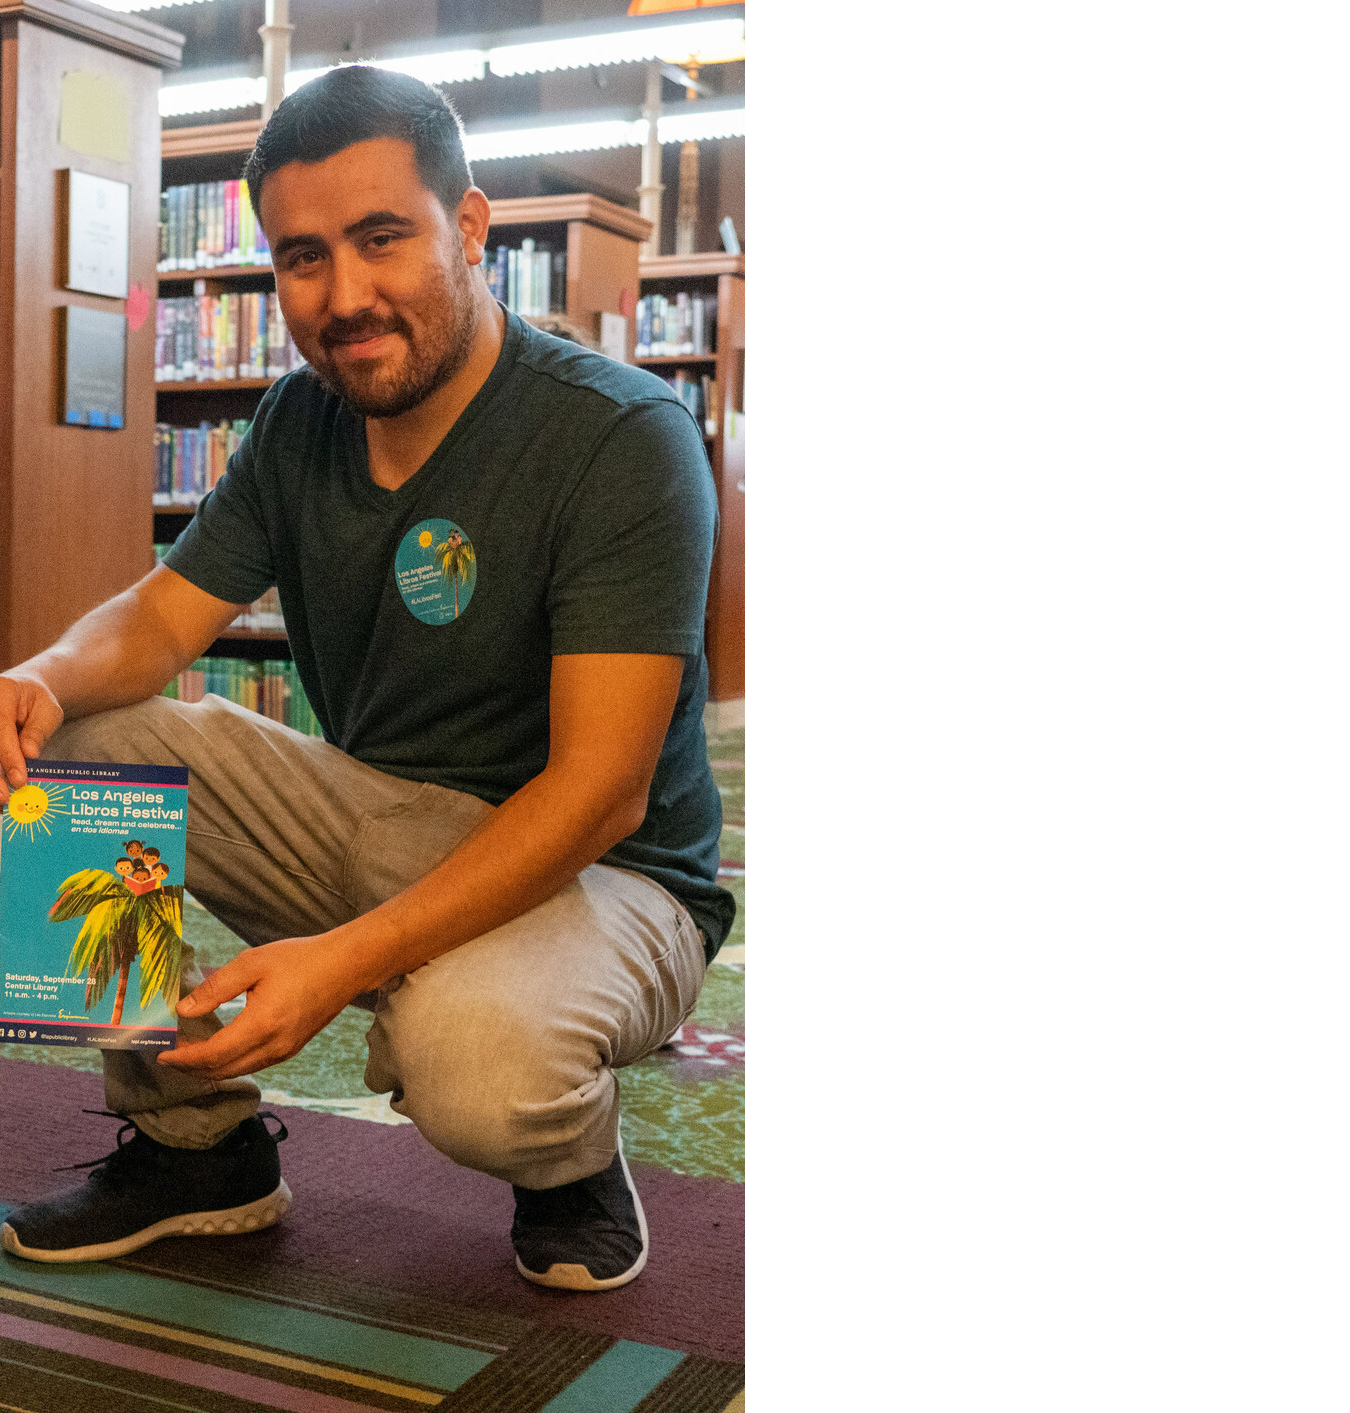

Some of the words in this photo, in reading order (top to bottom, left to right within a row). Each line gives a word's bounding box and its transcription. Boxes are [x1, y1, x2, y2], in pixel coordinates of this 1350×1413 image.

[72, 788, 99, 801] Los
[103, 790, 164, 805] Angeles
[71, 803, 119, 817] Libros
[123, 806, 183, 820] Festival
[71, 818, 93, 826] Read,
[94, 819, 120, 827] dream
[121, 820, 136, 828] and
[137, 822, 182, 830] celebrate...
[82, 826, 97, 834] dos
[98, 827, 130, 835] idiomas
[5, 973, 41, 983] Saturday,
[43, 975, 86, 985] September
[87, 977, 96, 985] 28
[5, 982, 31, 990] Central
[32, 983, 59, 993] Library
